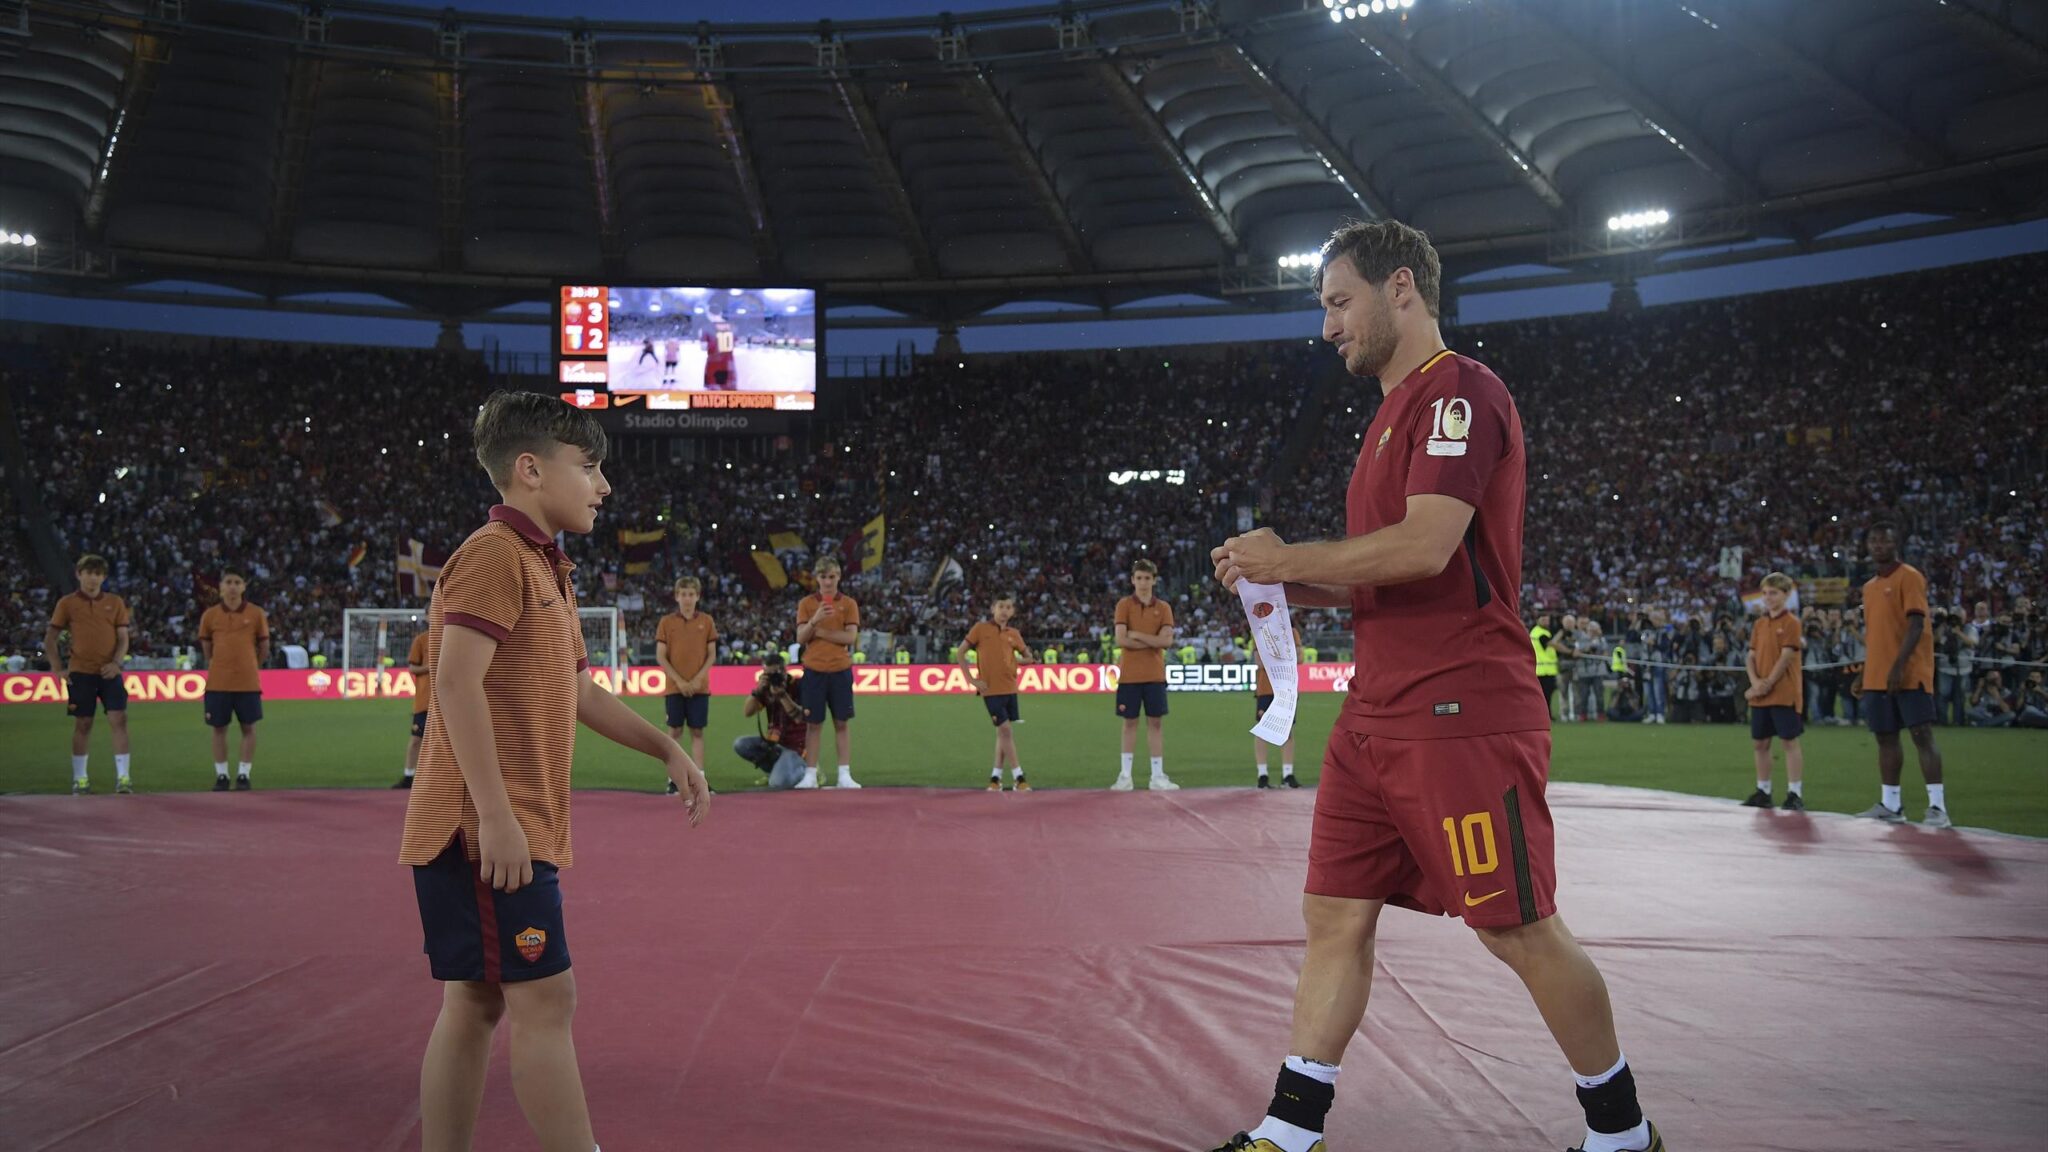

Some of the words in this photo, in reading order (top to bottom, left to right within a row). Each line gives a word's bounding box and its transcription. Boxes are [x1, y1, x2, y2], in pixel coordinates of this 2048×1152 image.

[587, 302, 603, 323] 3
[588, 328, 603, 349] 2
[692, 395, 727, 408] MATCH
[728, 395, 774, 409] SPONSOR
[625, 413, 675, 428] Stadio
[679, 413, 748, 430] Olimpico
[1428, 397, 1472, 440] 10
[3, 673, 206, 702] CAANO
[338, 671, 416, 697] GRA
[919, 667, 1094, 692] CAANO
[1443, 811, 1498, 876] 10
